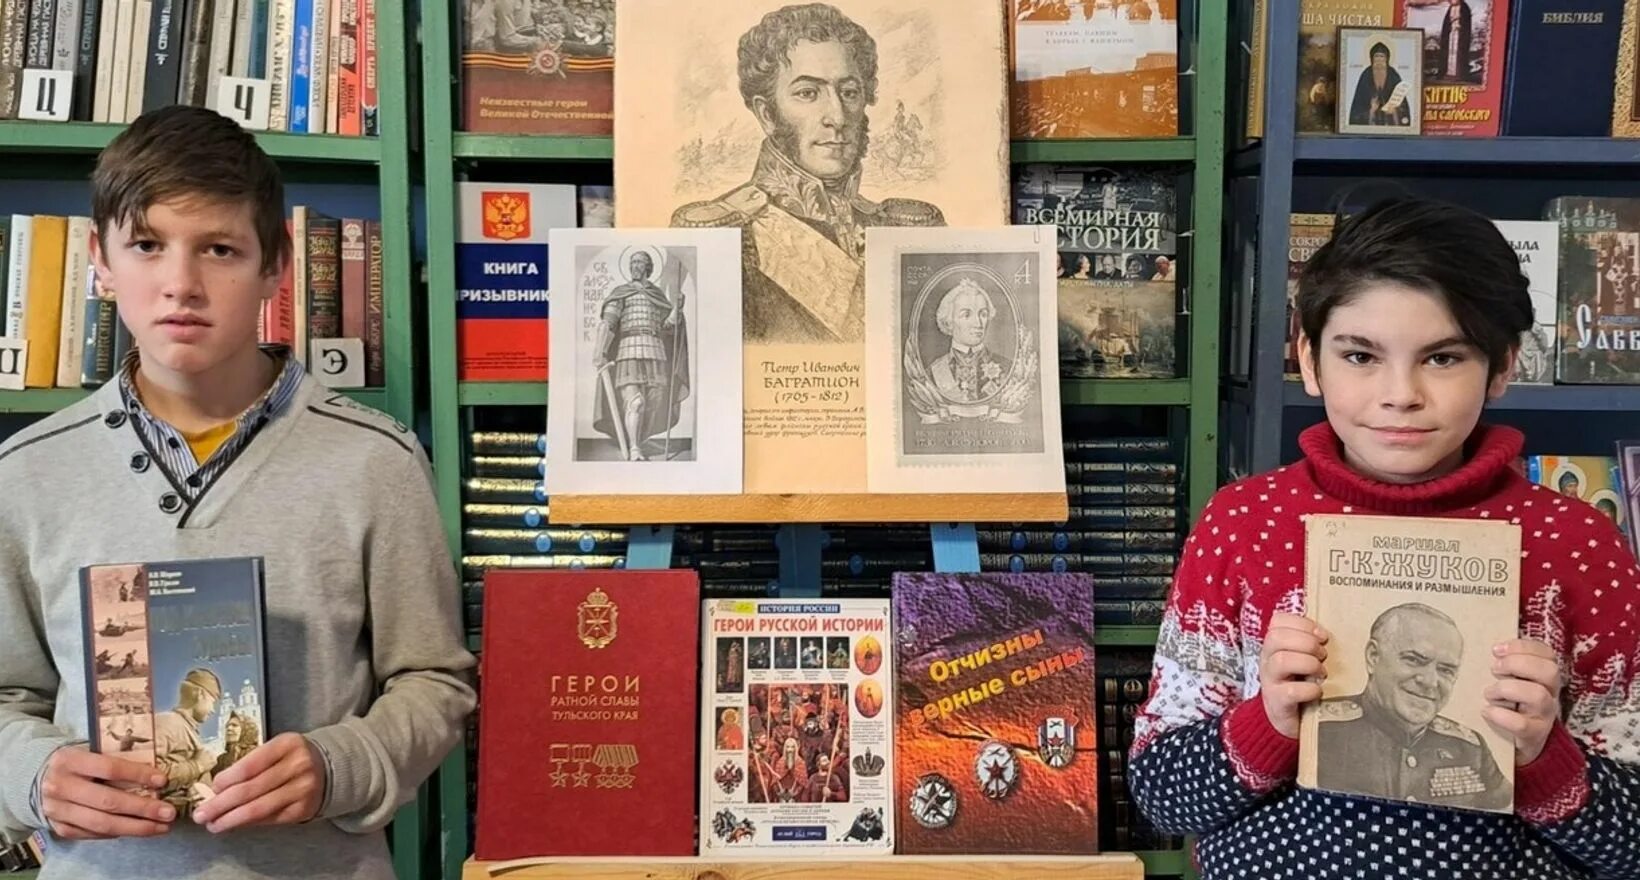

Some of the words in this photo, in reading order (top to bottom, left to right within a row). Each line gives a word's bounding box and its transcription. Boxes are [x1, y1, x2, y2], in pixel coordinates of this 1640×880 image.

[1329, 14, 1382, 26] ЧИСТАЯ
[1542, 12, 1604, 24] БИБЛИЯ
[36, 77, 56, 116] Ц
[235, 84, 254, 121] Ч
[479, 97, 553, 107] Неизвестные
[556, 100, 588, 108] герои
[480, 108, 529, 118] Великой
[1027, 207, 1160, 227] ВСЕМИРНАЯ
[1057, 226, 1160, 250] СТОРИЯ
[369, 235, 382, 314] ИМПЕРАТОР
[484, 262, 539, 275] КНИГА
[457, 289, 549, 302] РИЗЫВНИК
[322, 349, 348, 374] Э
[761, 361, 800, 374] Петр
[803, 361, 860, 373] Иванович
[764, 377, 859, 388] БАГРАТИОН
[1329, 575, 1413, 592] ВОСПОМИНАНИЯ
[1415, 582, 1422, 591] И
[1425, 582, 1506, 597] РАЗМЫШЛЕНИЯ
[760, 603, 801, 613] ИСТОРИЯ
[803, 603, 839, 613] РОССИИ
[714, 618, 755, 632] ГЕРОИ
[759, 615, 817, 632] РУССКОЙ
[822, 619, 883, 632] ИСТОРИИ
[929, 629, 1044, 682] Отчизны
[551, 675, 640, 692] ГЕРОИ
[909, 677, 1004, 726] верные
[1011, 647, 1084, 686] сыны
[551, 695, 598, 707] РАТНОЙ
[600, 697, 640, 707] СЛАВЫ
[552, 711, 611, 721] ТУЛЬСКОГО
[613, 711, 638, 721] КРАЯ
